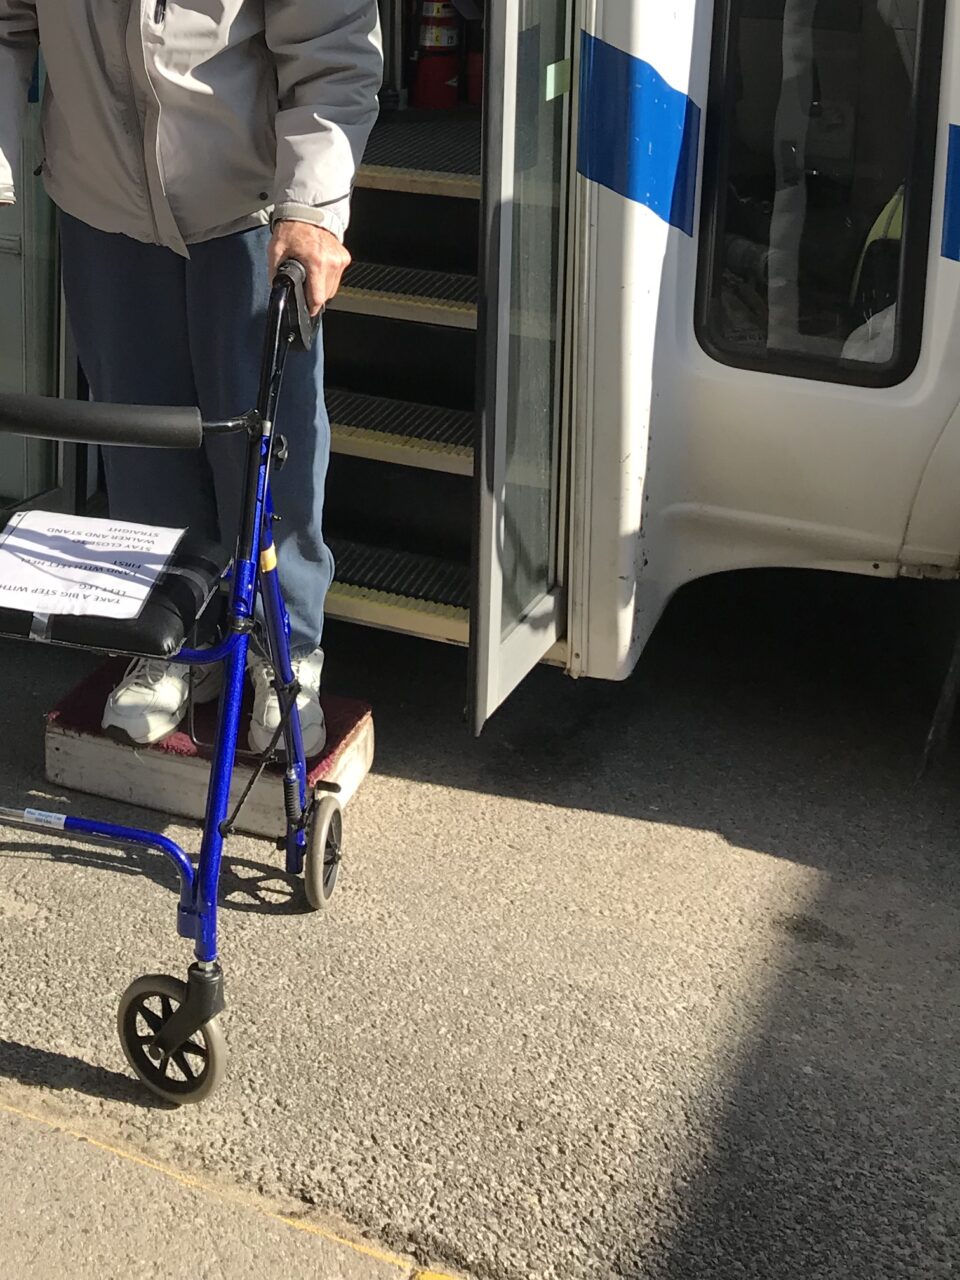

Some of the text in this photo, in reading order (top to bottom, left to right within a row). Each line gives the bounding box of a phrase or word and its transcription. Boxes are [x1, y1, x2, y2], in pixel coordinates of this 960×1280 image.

[47, 527, 81, 536] STAND
[107, 527, 160, 538] STRAIGHT
[111, 535, 155, 545] WALKER
[126, 544, 151, 552] STAY
[114, 560, 141, 569] FIRST
[31, 587, 57, 596] STEP
[94, 594, 121, 604] TAKE
